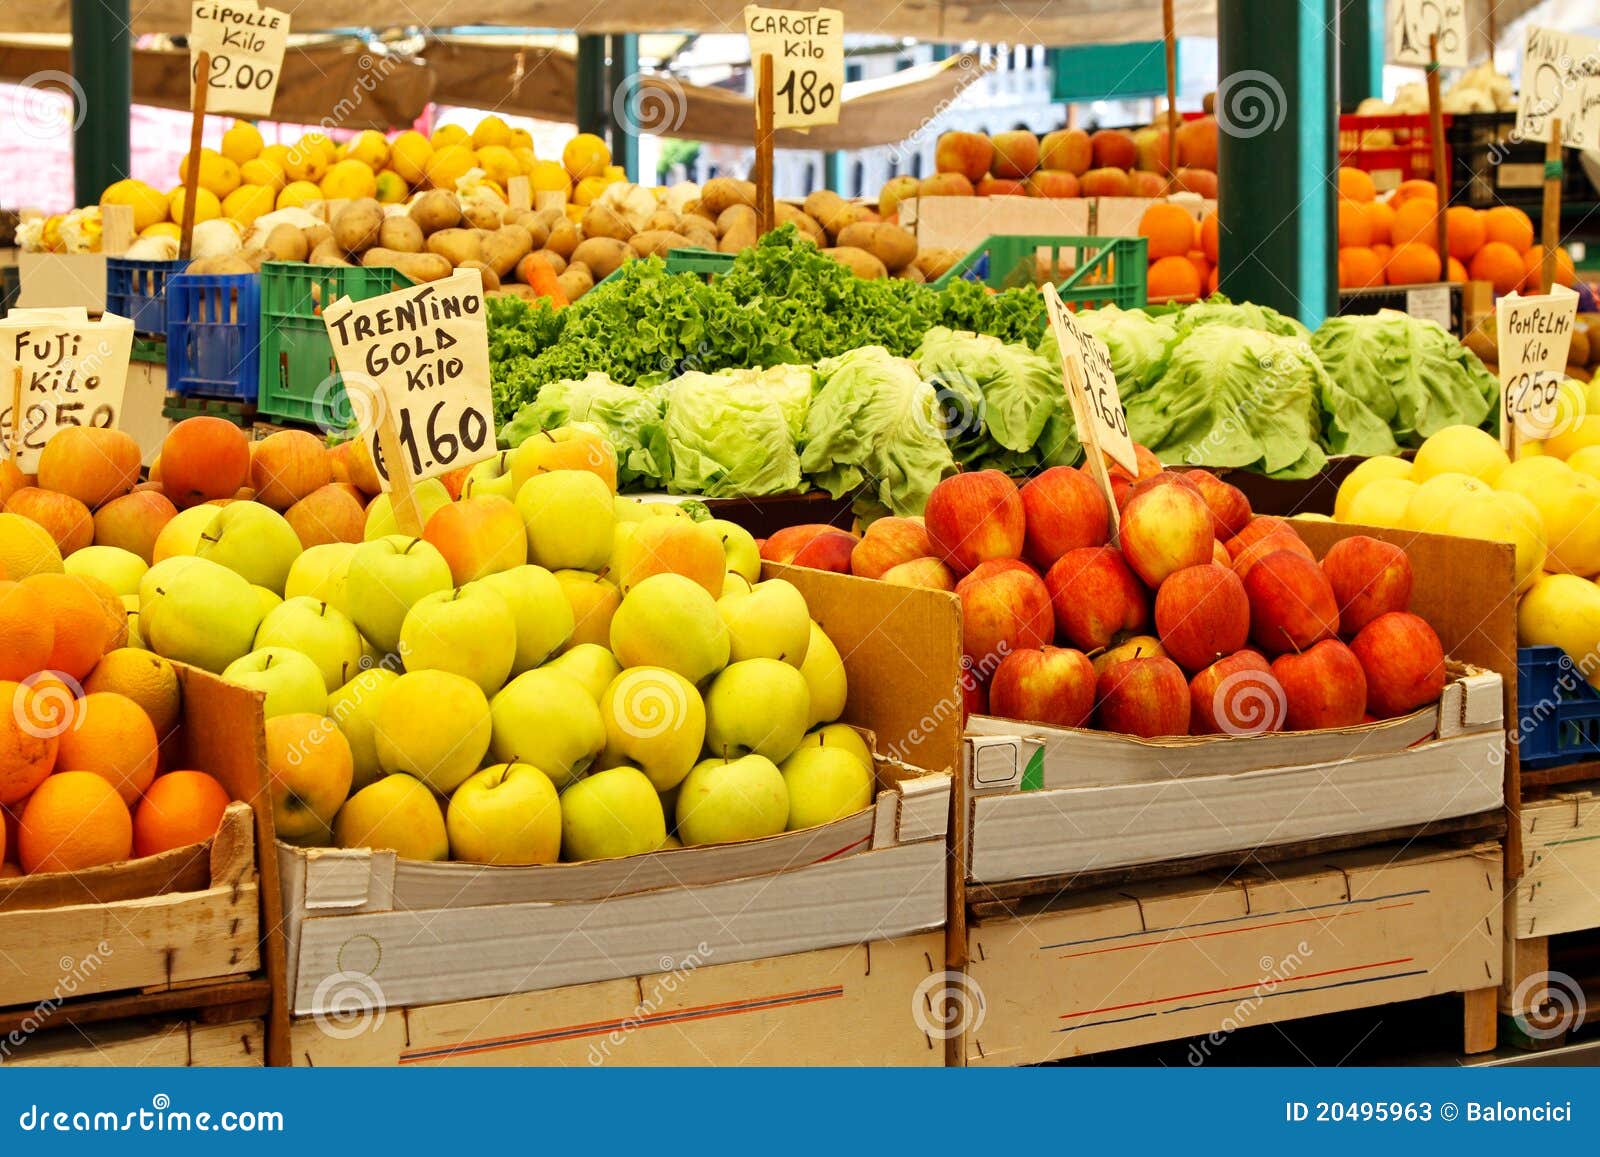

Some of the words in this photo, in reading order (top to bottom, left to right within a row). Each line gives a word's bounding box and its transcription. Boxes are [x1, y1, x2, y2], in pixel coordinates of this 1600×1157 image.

[750, 15, 832, 35] CAROTE
[222, 27, 265, 52] Kilo
[784, 40, 824, 59] Kilo
[192, 55, 273, 90] 2.00
[366, 328, 457, 377] GOLD
[1522, 338, 1548, 364] Kilo
